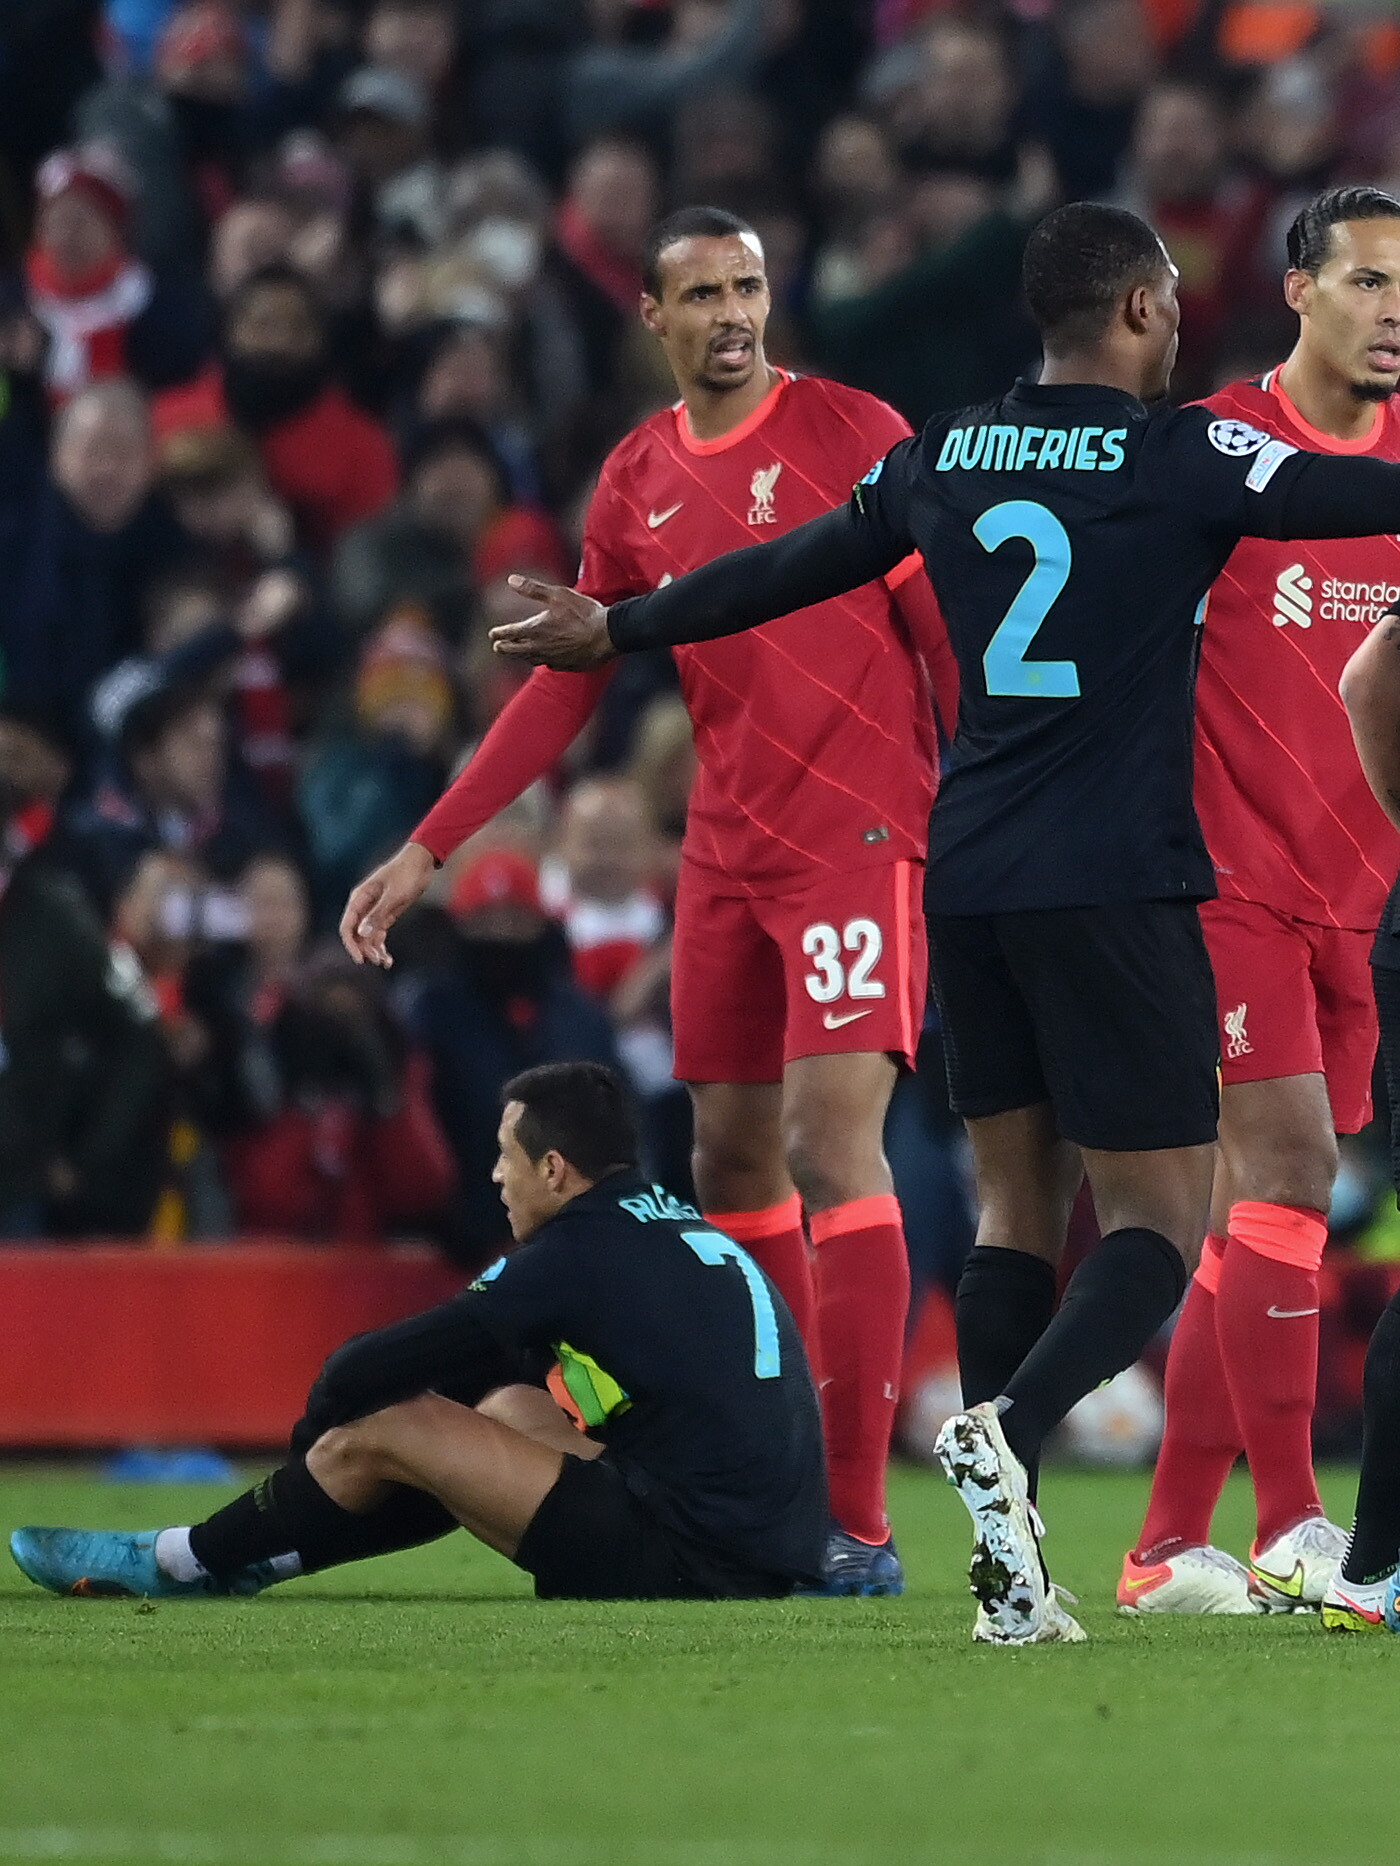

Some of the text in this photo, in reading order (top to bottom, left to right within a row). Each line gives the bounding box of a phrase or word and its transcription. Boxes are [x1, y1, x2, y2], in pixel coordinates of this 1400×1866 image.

[935, 425, 1128, 471] DUMFRIES
[747, 510, 778, 526] LFC
[972, 500, 1081, 697] 2
[803, 921, 885, 1003] 32
[1227, 1042, 1254, 1058] LFC
[680, 1232, 781, 1379] 7
